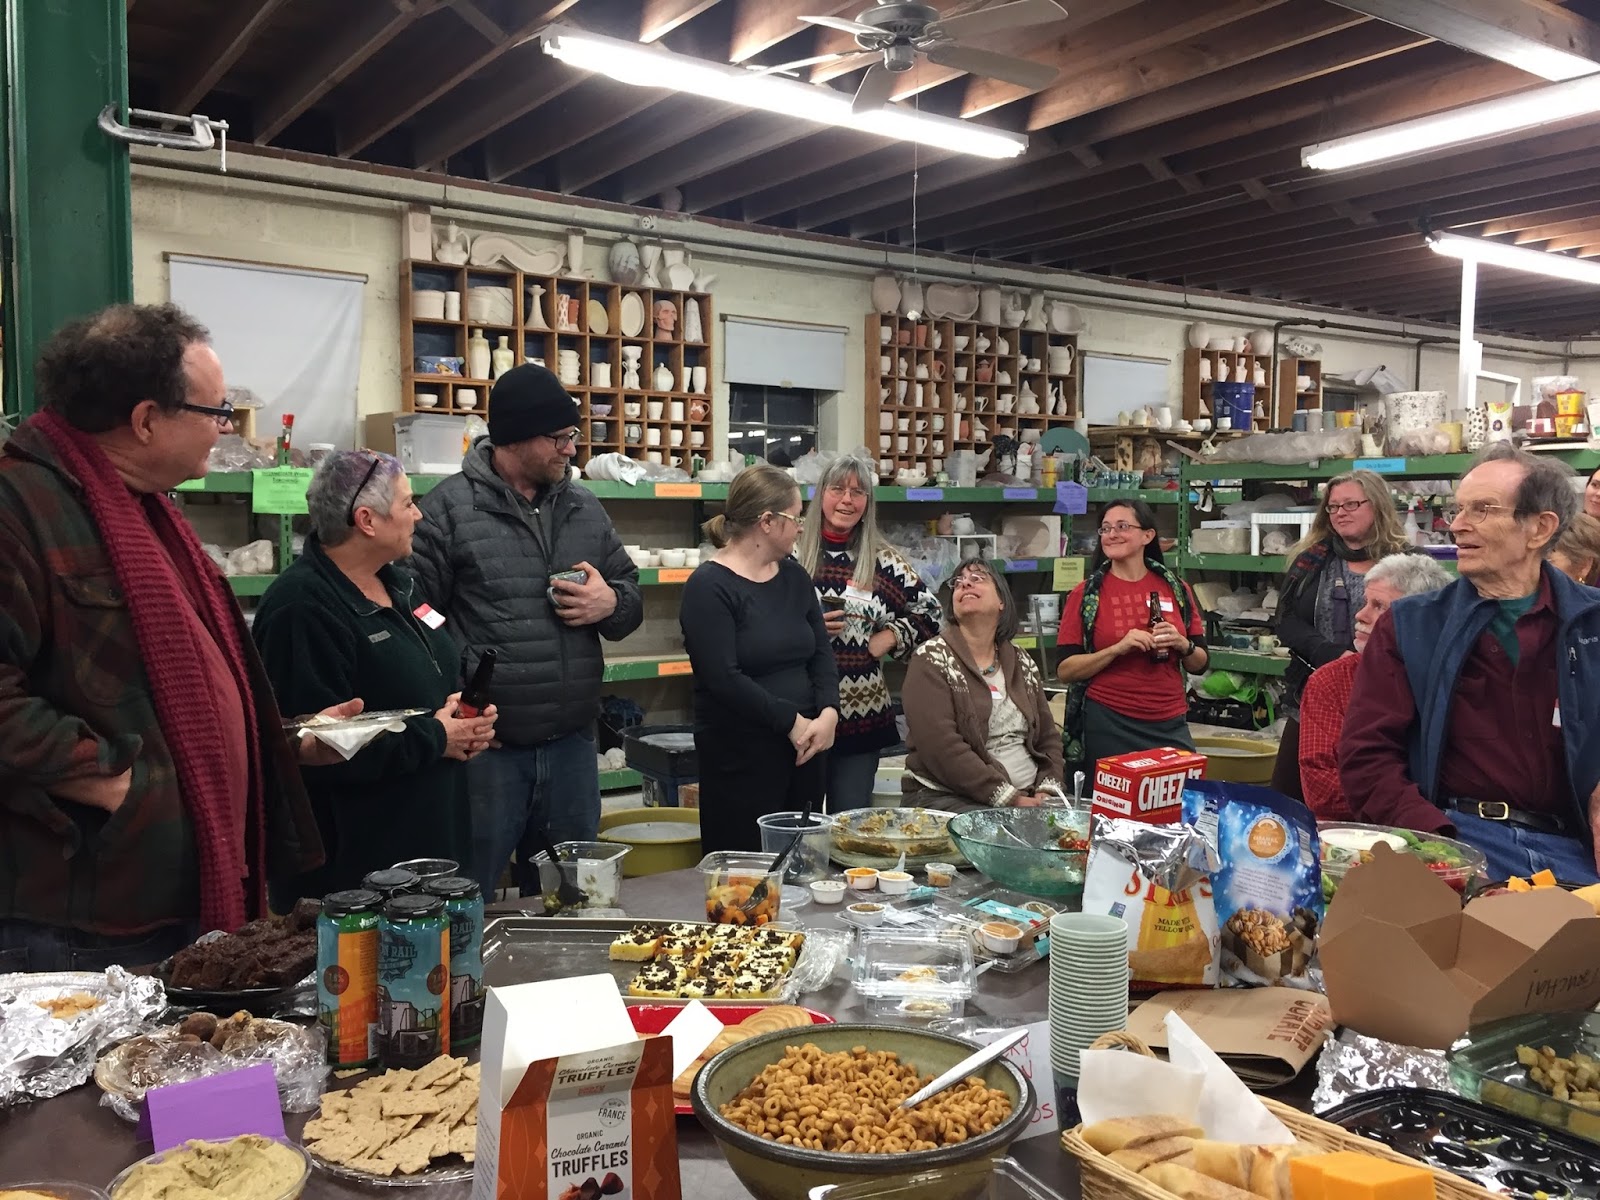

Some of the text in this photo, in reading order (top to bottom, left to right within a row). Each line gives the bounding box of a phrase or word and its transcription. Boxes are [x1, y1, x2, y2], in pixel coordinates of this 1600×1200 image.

[1158, 917, 1181, 926] MADE
[1154, 924, 1183, 933] YELLOW
[391, 945, 417, 958] RAIL
[559, 1055, 640, 1076] Chocolate Caramel
[587, 1056, 615, 1064] ORGANIC
[558, 1065, 636, 1084] TRUFFLES
[598, 1107, 627, 1120] FRANCE
[576, 1129, 604, 1140] ORGANIC
[551, 1134, 630, 1160] Chocolate Caramel
[551, 1150, 629, 1178] TRUFFLES
